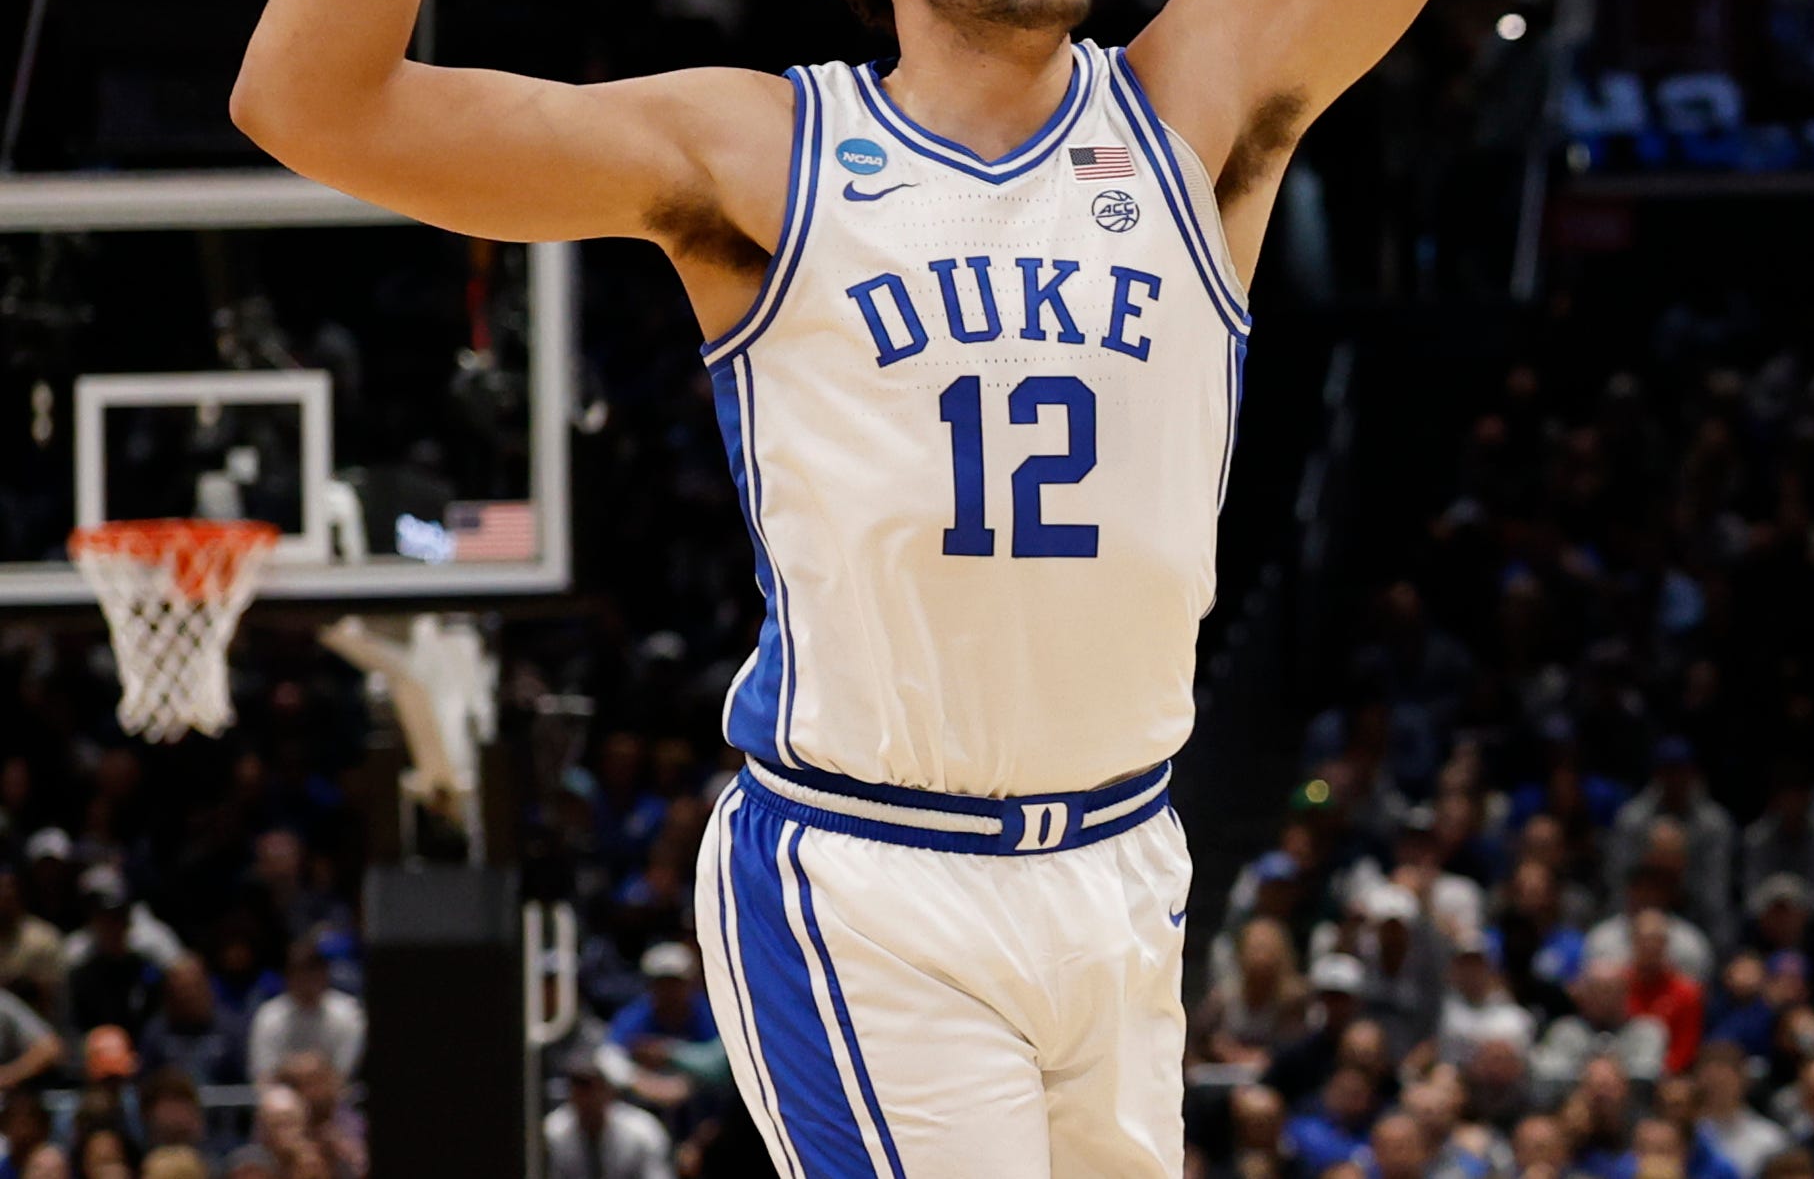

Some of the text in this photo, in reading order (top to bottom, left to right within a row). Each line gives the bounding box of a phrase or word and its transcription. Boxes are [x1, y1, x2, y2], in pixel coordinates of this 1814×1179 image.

[843, 151, 883, 167] NCAA
[1099, 202, 1134, 215] ACC
[846, 255, 1161, 367] DUKE
[940, 375, 1099, 558] 12
